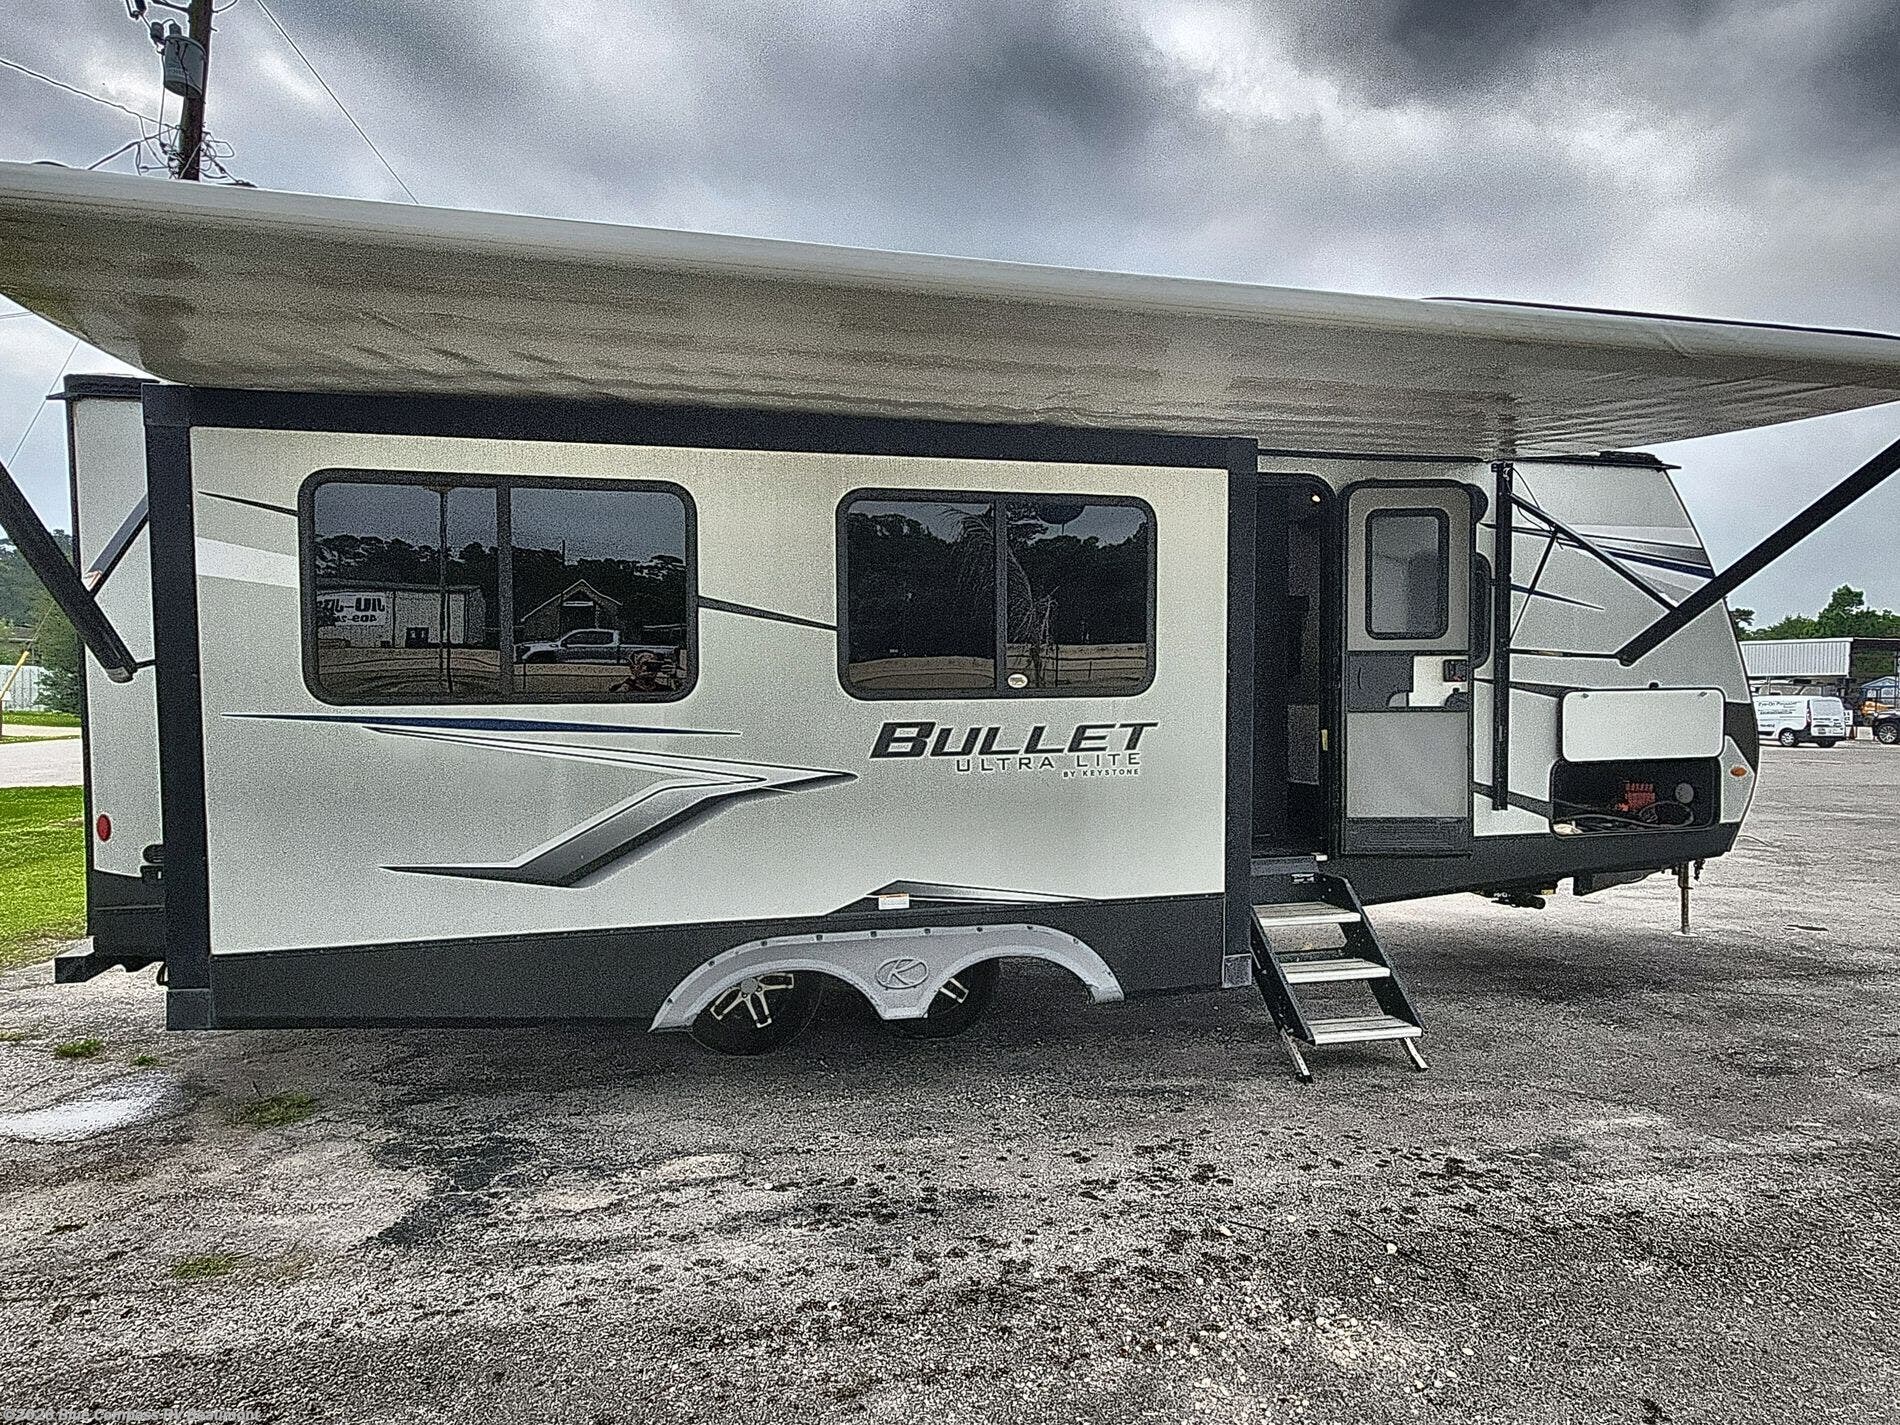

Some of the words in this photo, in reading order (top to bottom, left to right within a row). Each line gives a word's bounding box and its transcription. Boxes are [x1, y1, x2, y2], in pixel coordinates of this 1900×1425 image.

[870, 721, 1159, 758] BULLET
[956, 757, 1055, 772] ULTRA
[1076, 753, 1141, 768] LITE
[1063, 770, 1076, 778] BY
[1083, 768, 1140, 777] KEYSTONE
